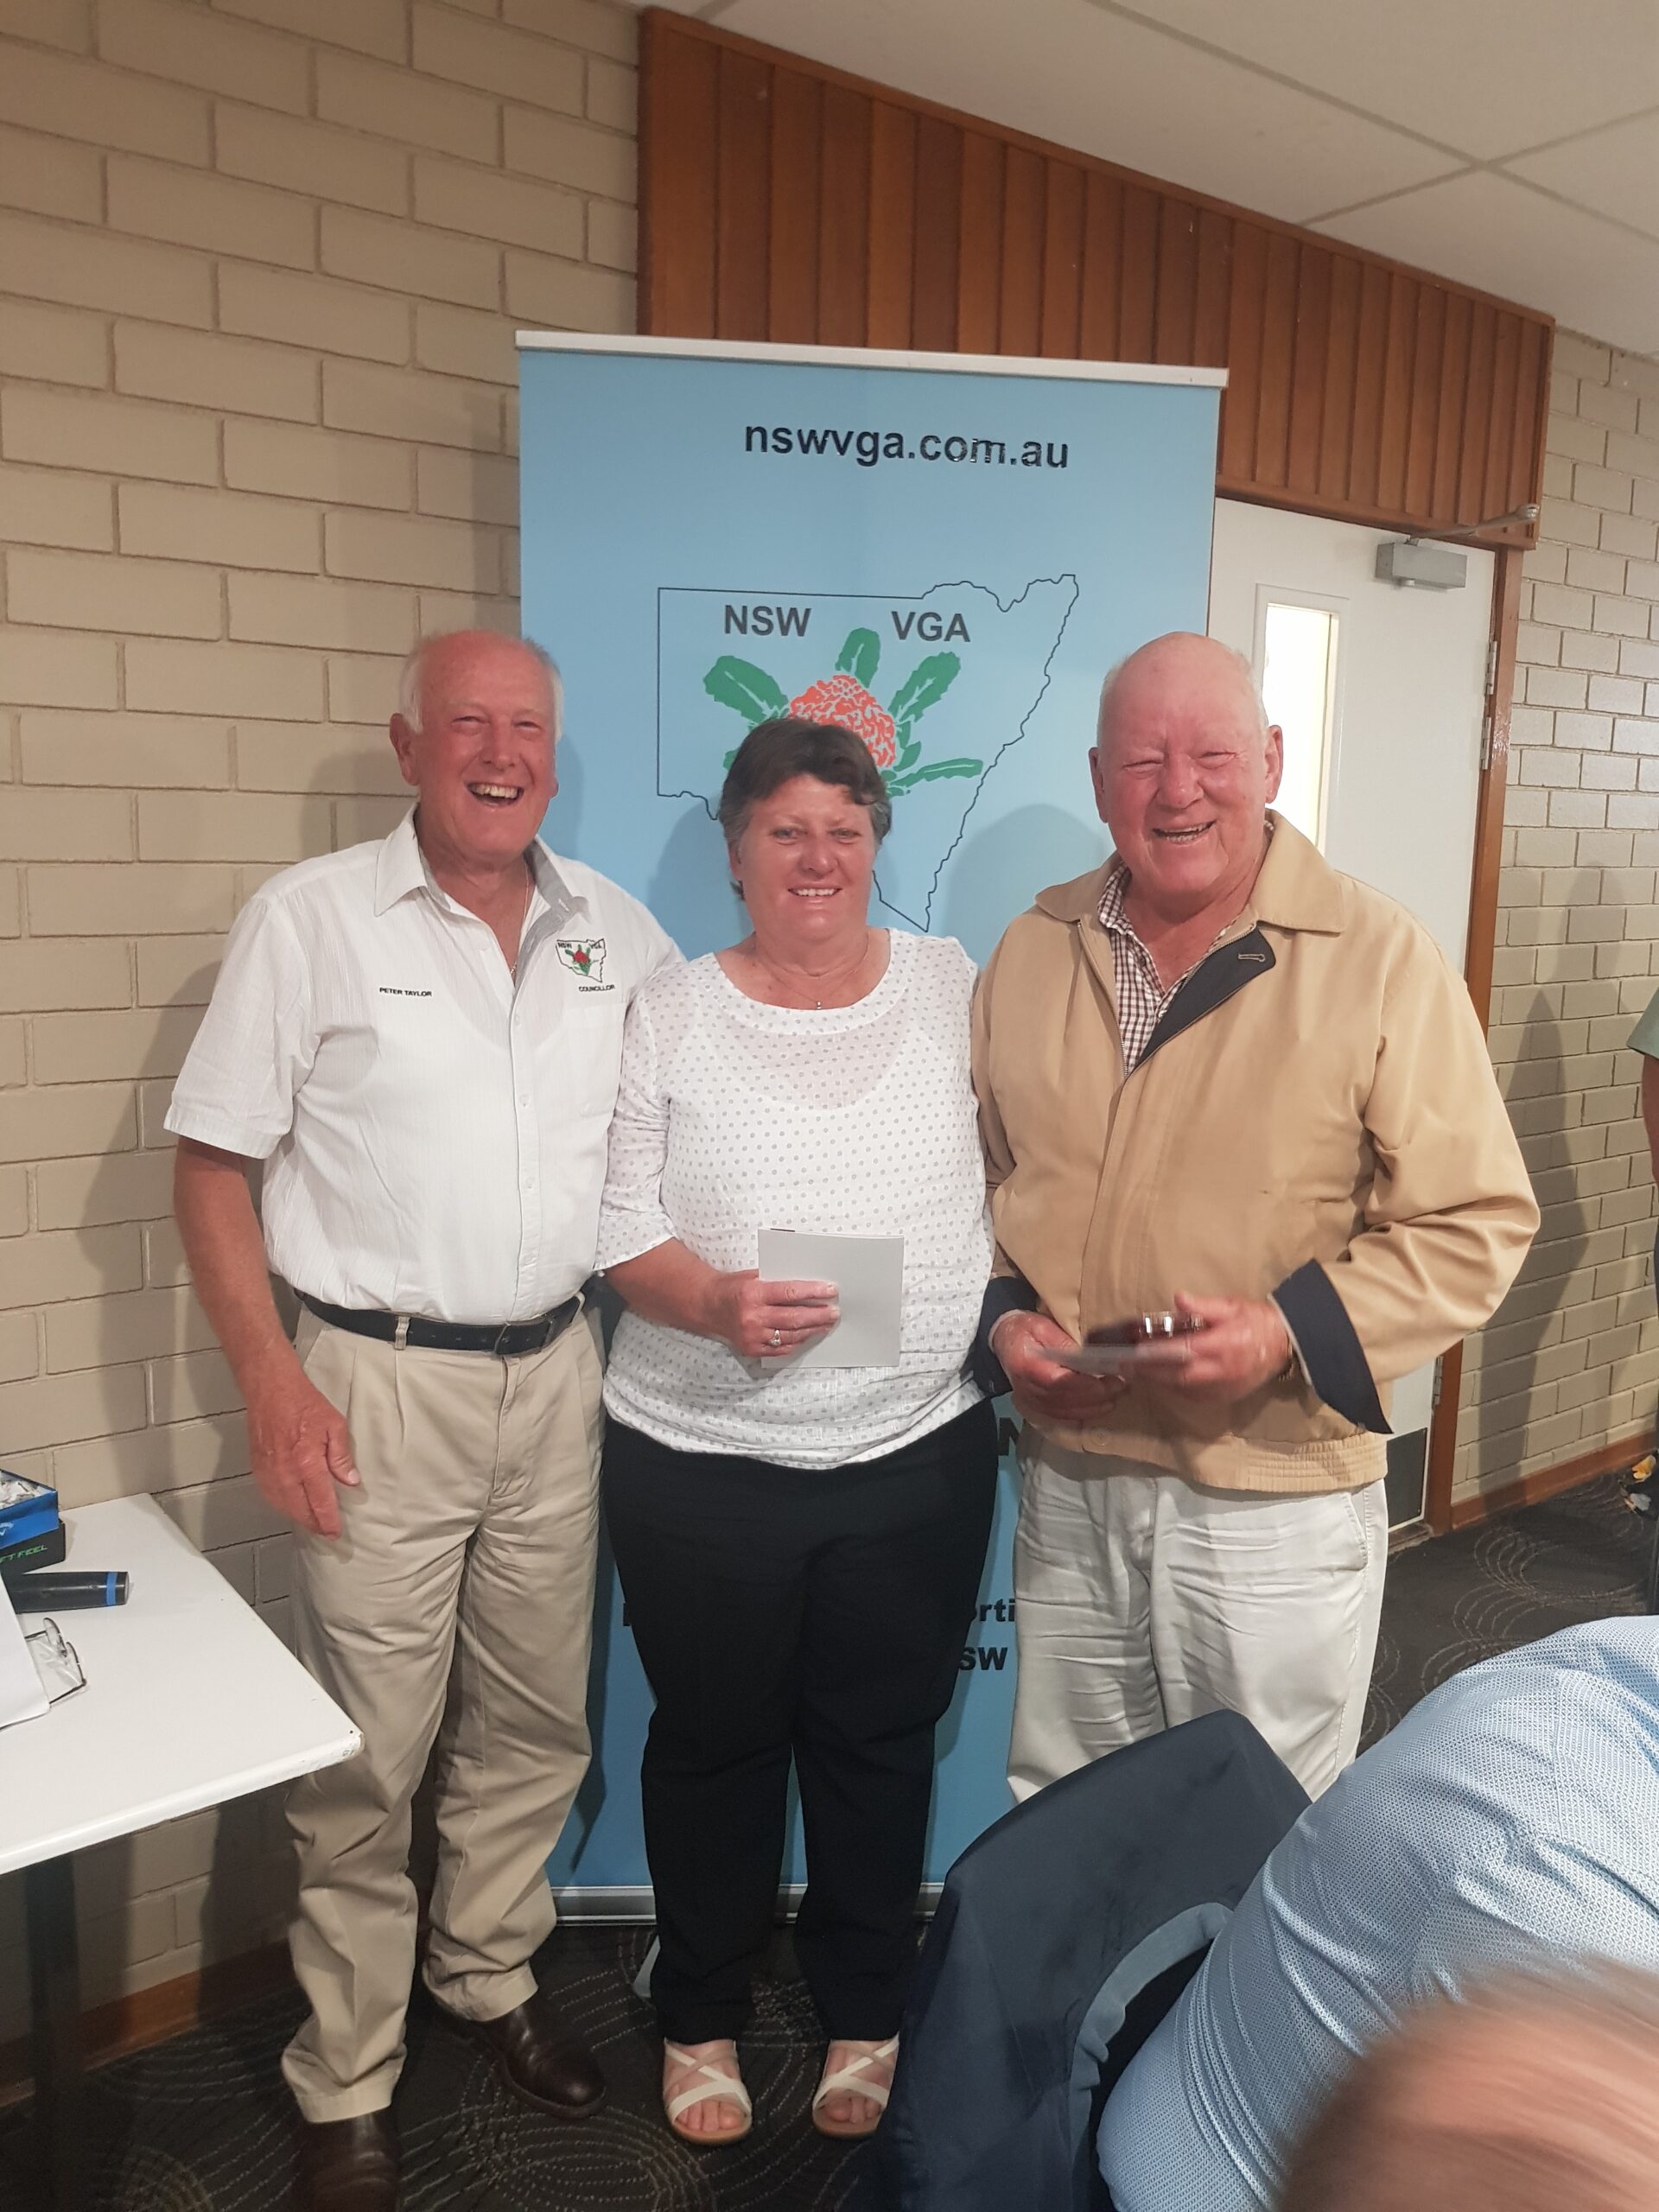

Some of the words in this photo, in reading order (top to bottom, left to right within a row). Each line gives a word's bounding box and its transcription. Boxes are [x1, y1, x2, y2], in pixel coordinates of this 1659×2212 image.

[745, 424, 1069, 467] nswvga.com.au
[724, 604, 811, 637] NSW
[891, 610, 971, 643] VGA
[379, 987, 403, 995] PETER
[958, 1646, 1008, 1671] SW
